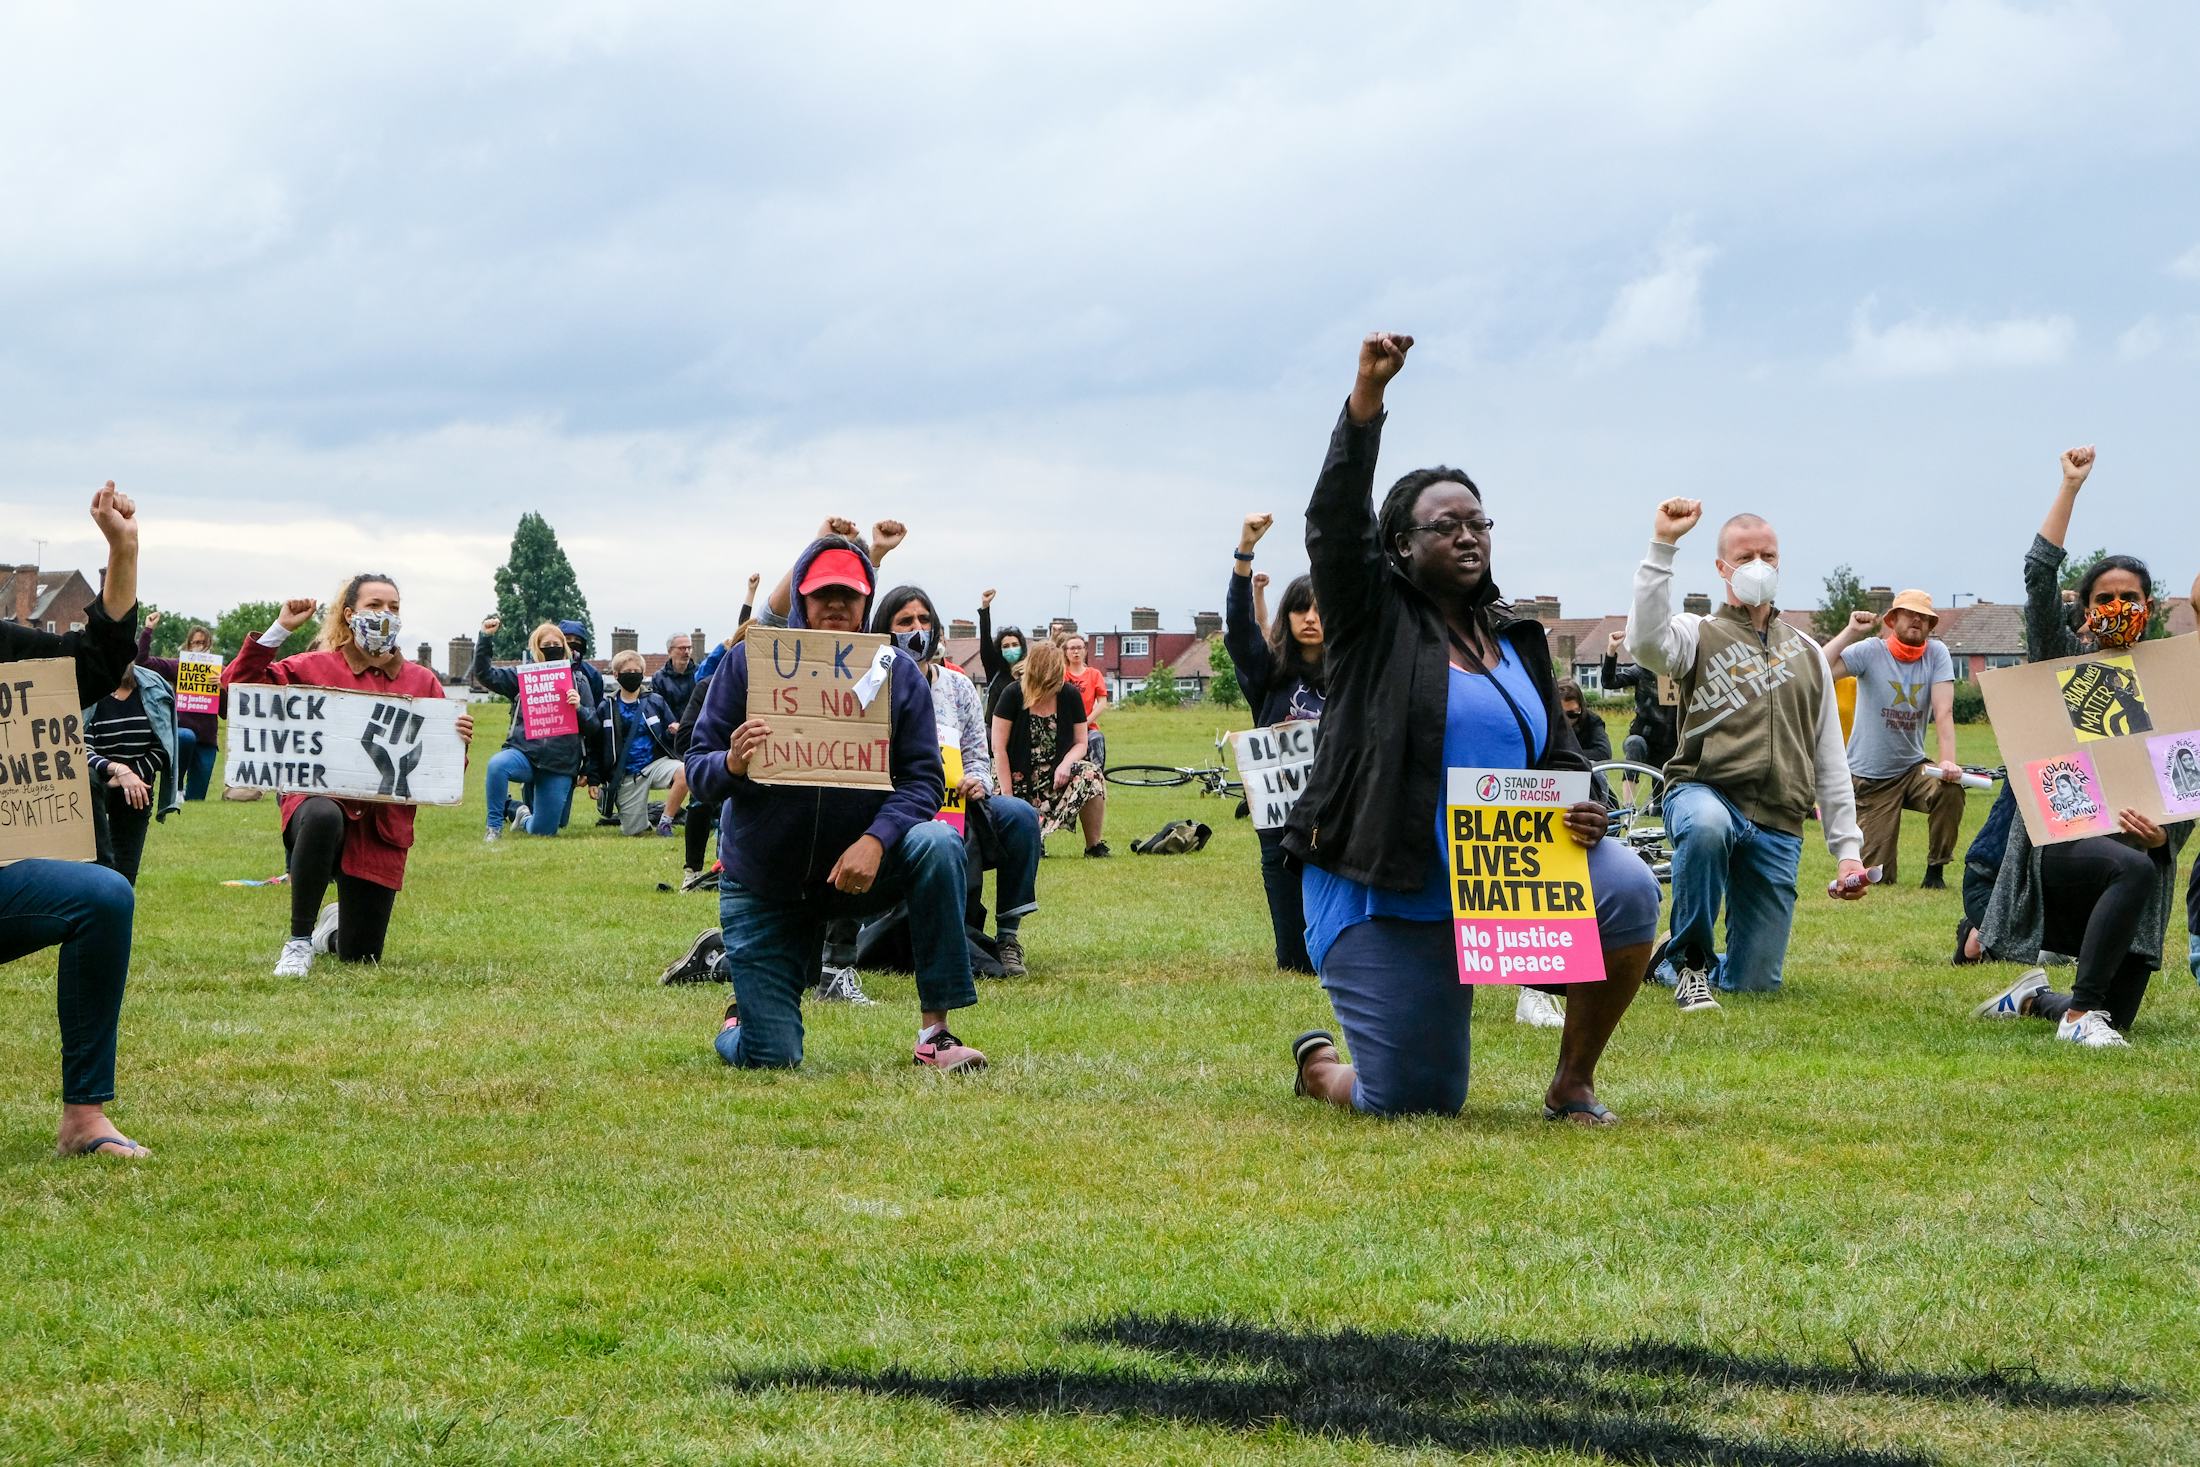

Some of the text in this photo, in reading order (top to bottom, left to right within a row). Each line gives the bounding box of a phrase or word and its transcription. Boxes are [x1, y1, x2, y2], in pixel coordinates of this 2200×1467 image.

[180, 662, 211, 673] BLACK
[180, 672, 206, 682] LIVES
[524, 671, 566, 684] No more
[179, 682, 218, 693] MATTER
[525, 681, 555, 694] BAME
[188, 695, 212, 703] justice
[527, 692, 560, 705] deaths
[773, 686, 865, 717] IS NO
[238, 692, 326, 720] BLACK
[528, 703, 559, 715] Public
[2081, 685, 2115, 733] MATTER
[529, 714, 564, 727] inquiry
[31, 714, 81, 748] FOR
[531, 727, 550, 736] now
[243, 728, 323, 756] LIVES
[762, 739, 889, 772] INNOCENT
[235, 760, 328, 788] MATTER
[2043, 761, 2090, 793] DECOLONIZE
[23, 784, 55, 796] Hughes
[1504, 776, 1556, 790] STAND UP
[1504, 789, 1560, 802] TO RACISM
[1, 791, 83, 827] SMATTER
[2050, 801, 2073, 812] YOUR
[2072, 804, 2101, 817] MIND!
[1453, 809, 1555, 843] BLACK
[1456, 845, 1540, 877] LIVES
[1457, 880, 1586, 912] MATTER
[1461, 925, 1573, 953] No justice
[1463, 950, 1566, 977] No peace
